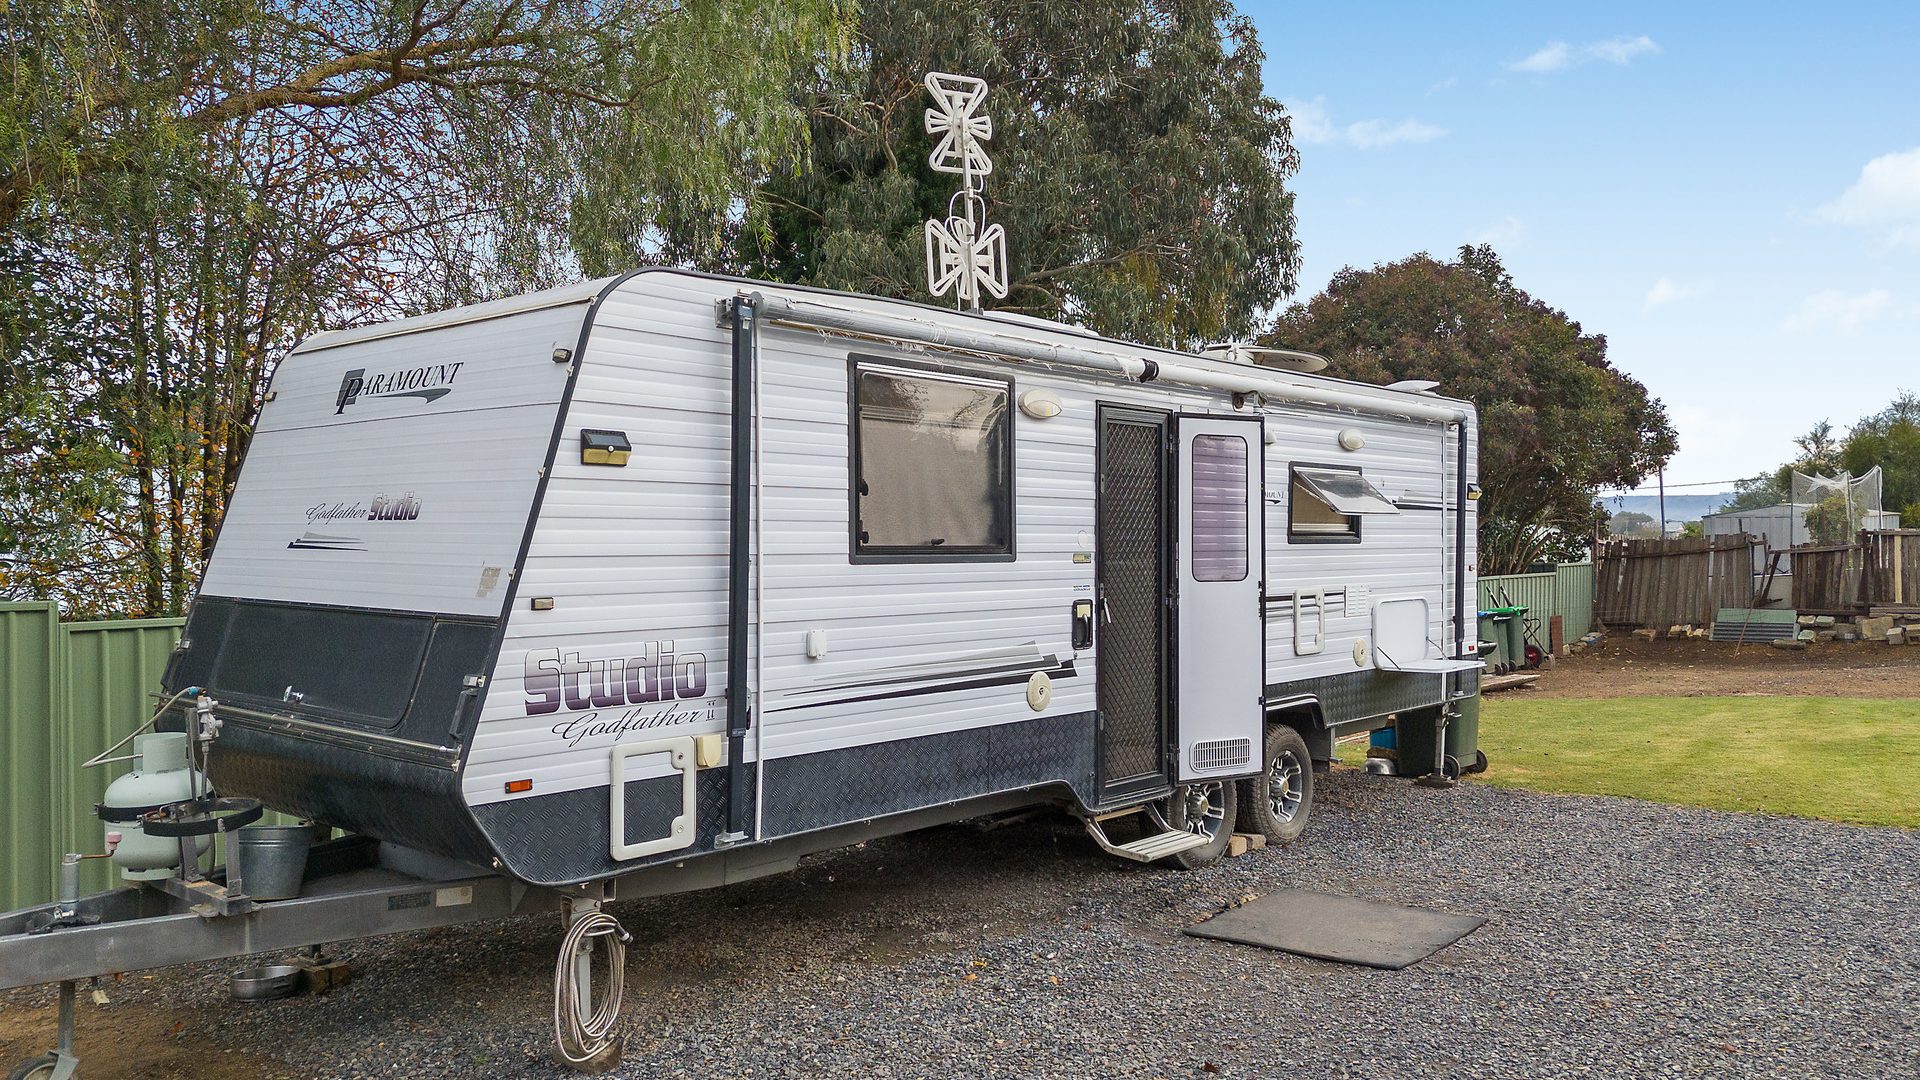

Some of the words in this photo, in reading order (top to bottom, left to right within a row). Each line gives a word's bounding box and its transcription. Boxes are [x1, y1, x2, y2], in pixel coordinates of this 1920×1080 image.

[334, 362, 464, 415] PARAMOUNT
[306, 503, 367, 524] Godfather
[368, 491, 422, 520] Studio
[524, 640, 707, 716] Studio
[552, 703, 703, 748] Godfather
